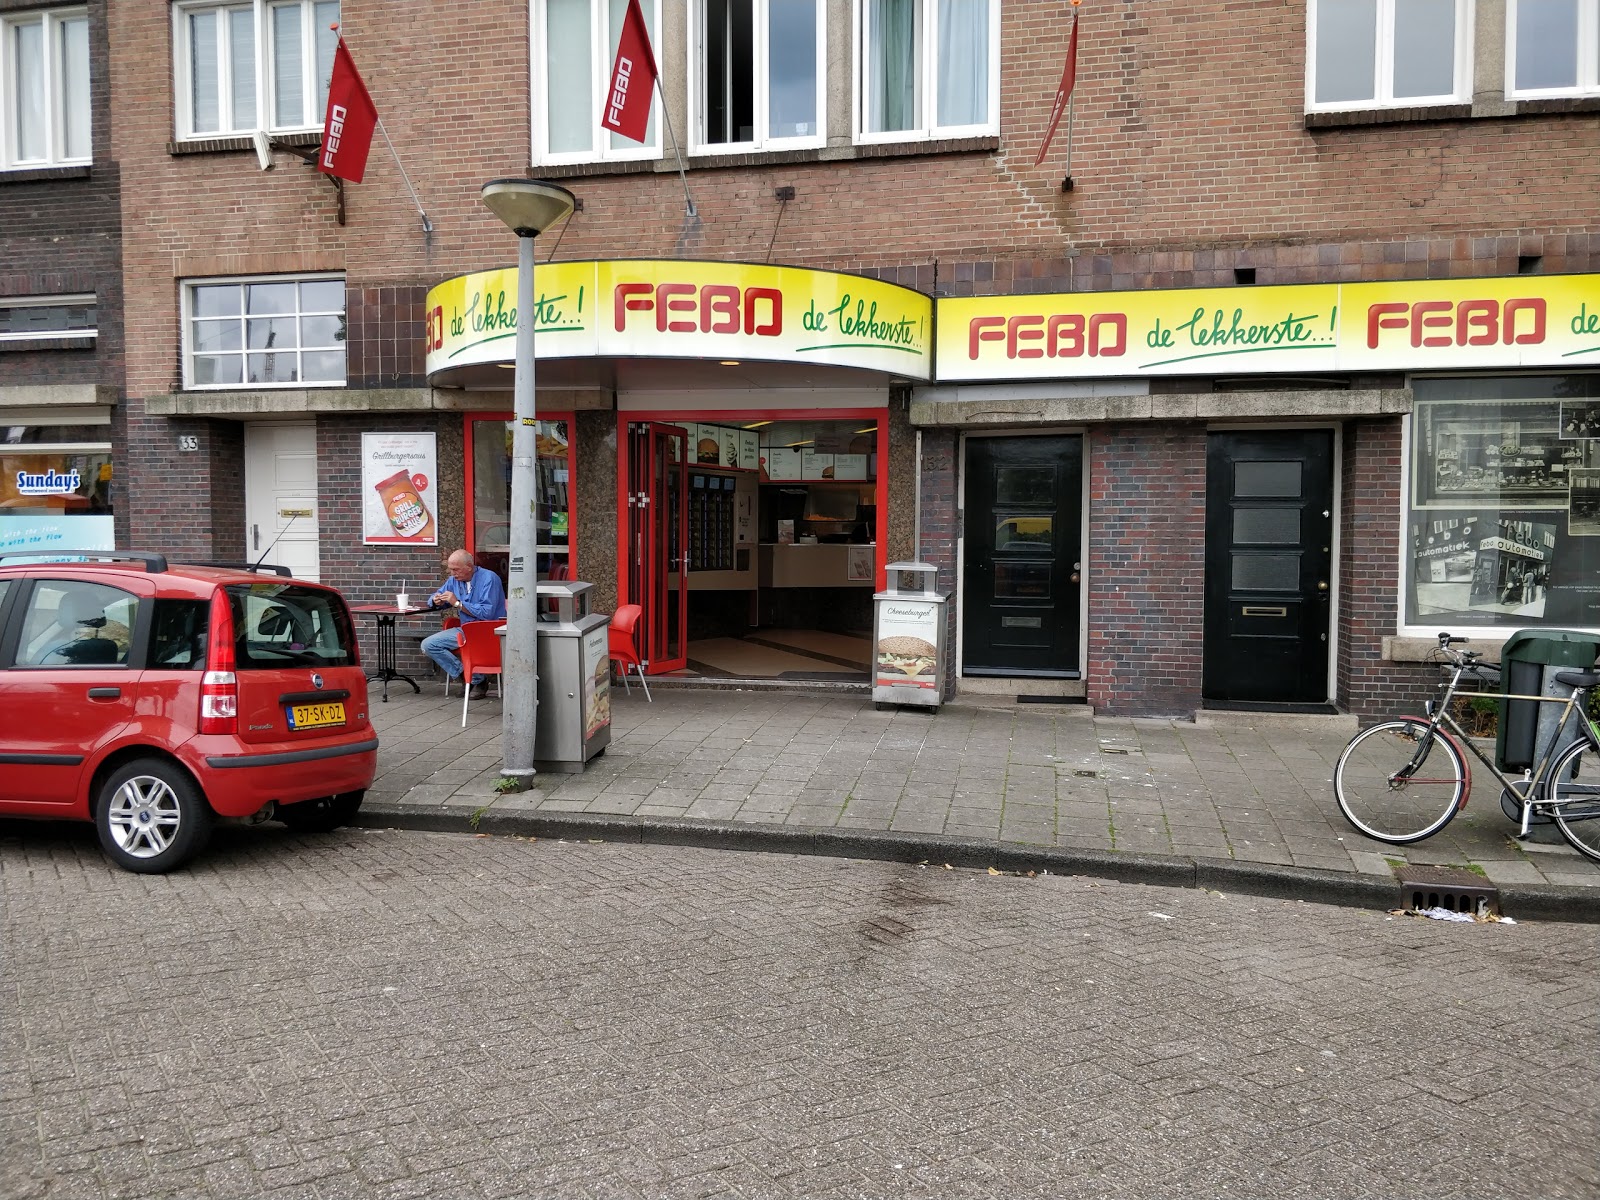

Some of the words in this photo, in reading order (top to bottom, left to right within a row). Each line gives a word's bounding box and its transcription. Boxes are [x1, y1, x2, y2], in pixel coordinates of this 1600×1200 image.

[608, 56, 633, 127] FEBO
[323, 104, 347, 169] FEBO
[426, 305, 443, 355] BO
[451, 306, 465, 337] de
[465, 285, 584, 333] lekkete...!
[614, 283, 783, 337] FEBO
[802, 298, 828, 332] de
[1367, 297, 1547, 349] FEBO
[1571, 302, 1600, 335] de
[968, 312, 1128, 361] FEBO
[1146, 318, 1176, 348] de
[372, 451, 426, 463] Grillburgersaus
[18, 470, 79, 492] Sunday's
[394, 499, 416, 516] GRILL
[395, 506, 423, 526] BURGER
[402, 516, 422, 533] SAUS
[1505, 524, 1540, 549] febo
[1417, 540, 1470, 558] automatiek
[1497, 541, 1544, 560] automatiek
[297, 706, 342, 723] 37-SK-DZ
